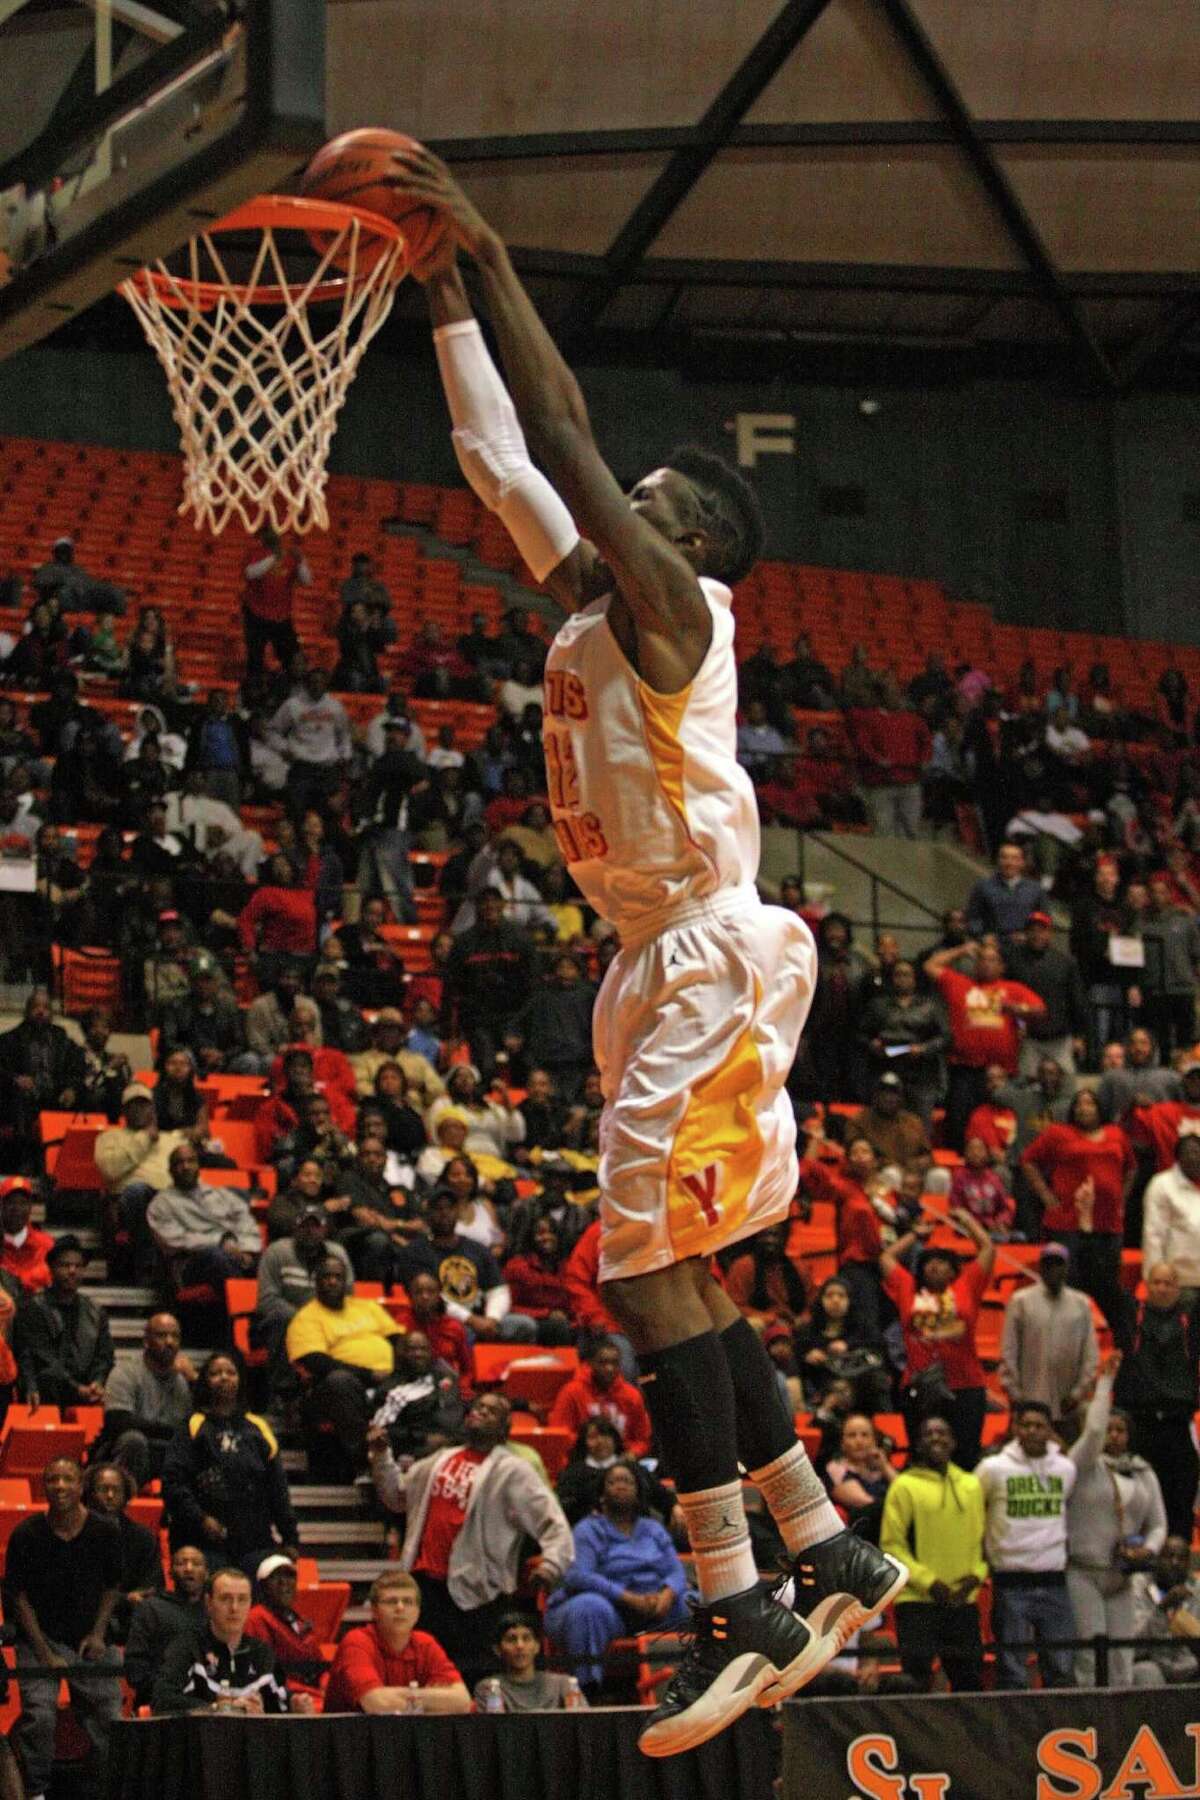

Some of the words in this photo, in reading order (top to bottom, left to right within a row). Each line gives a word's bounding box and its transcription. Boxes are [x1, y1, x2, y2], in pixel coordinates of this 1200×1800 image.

[737, 413, 796, 466] F
[681, 1164, 720, 1227] Y
[1036, 1723, 1200, 1800] SA
